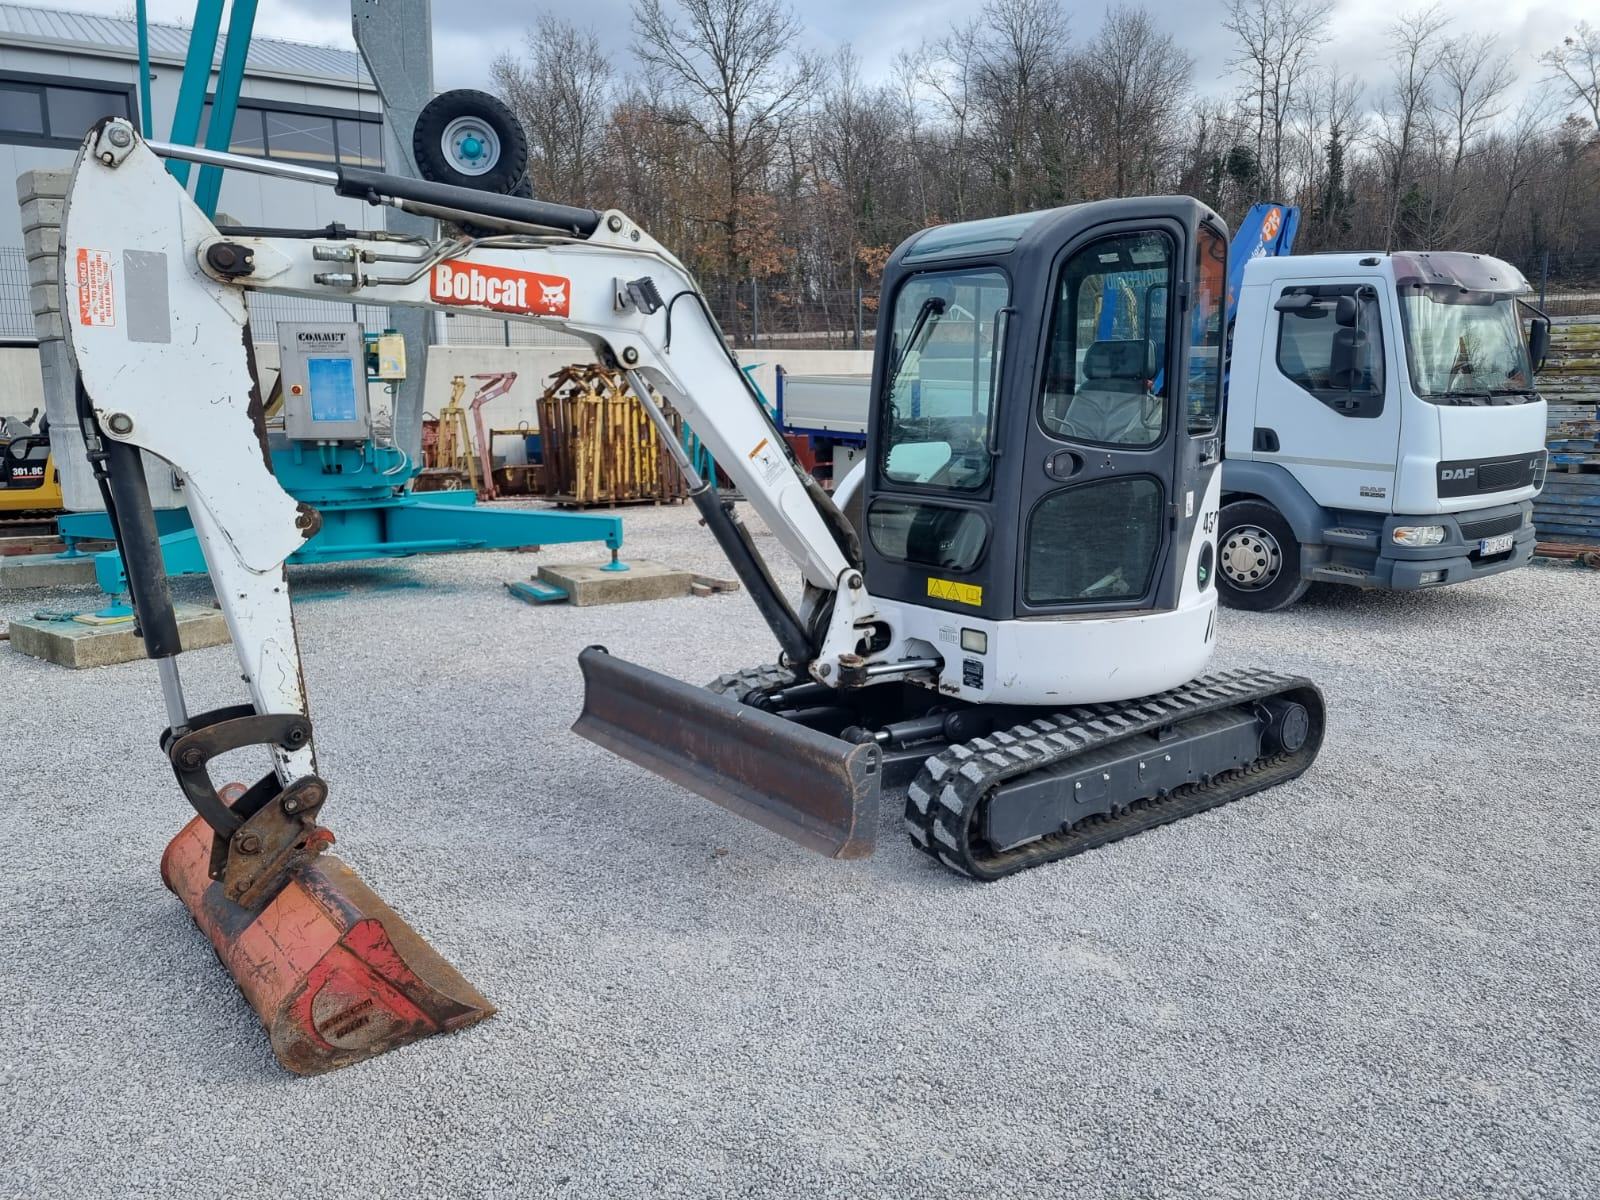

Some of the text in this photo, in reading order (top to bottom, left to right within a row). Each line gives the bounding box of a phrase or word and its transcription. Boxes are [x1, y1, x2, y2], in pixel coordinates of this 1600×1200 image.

[435, 264, 528, 308] Bobcat
[298, 333, 346, 341] COMMET
[12, 467, 43, 476] 301.8C
[1441, 468, 1475, 480] DAF
